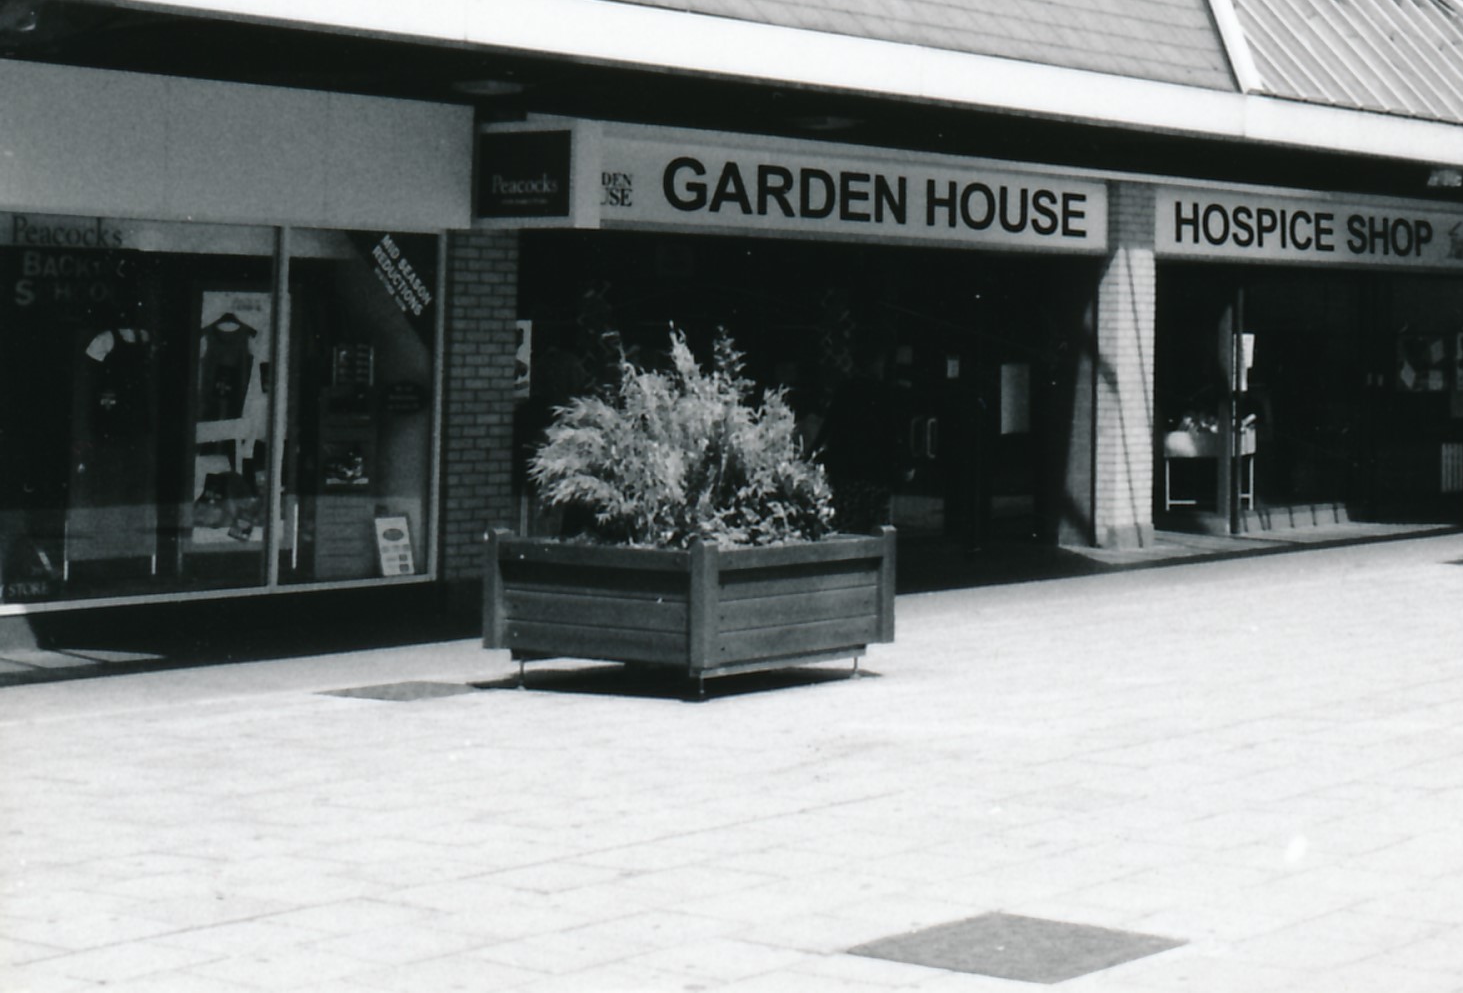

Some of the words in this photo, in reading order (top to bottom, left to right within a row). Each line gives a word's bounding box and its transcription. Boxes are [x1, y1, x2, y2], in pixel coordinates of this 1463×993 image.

[491, 172, 559, 195] Peacocks
[601, 171, 633, 187] DEN
[662, 157, 907, 225] GARDEN
[926, 179, 1088, 238] HOUSE
[12, 214, 122, 248] Peacocks
[1174, 201, 1335, 252] HOSPICE
[1346, 213, 1434, 257] SHOP
[23, 250, 91, 278] BACK
[371, 244, 424, 317] REDUCTIONS
[380, 233, 401, 260] MID
[397, 257, 433, 306] SEASON
